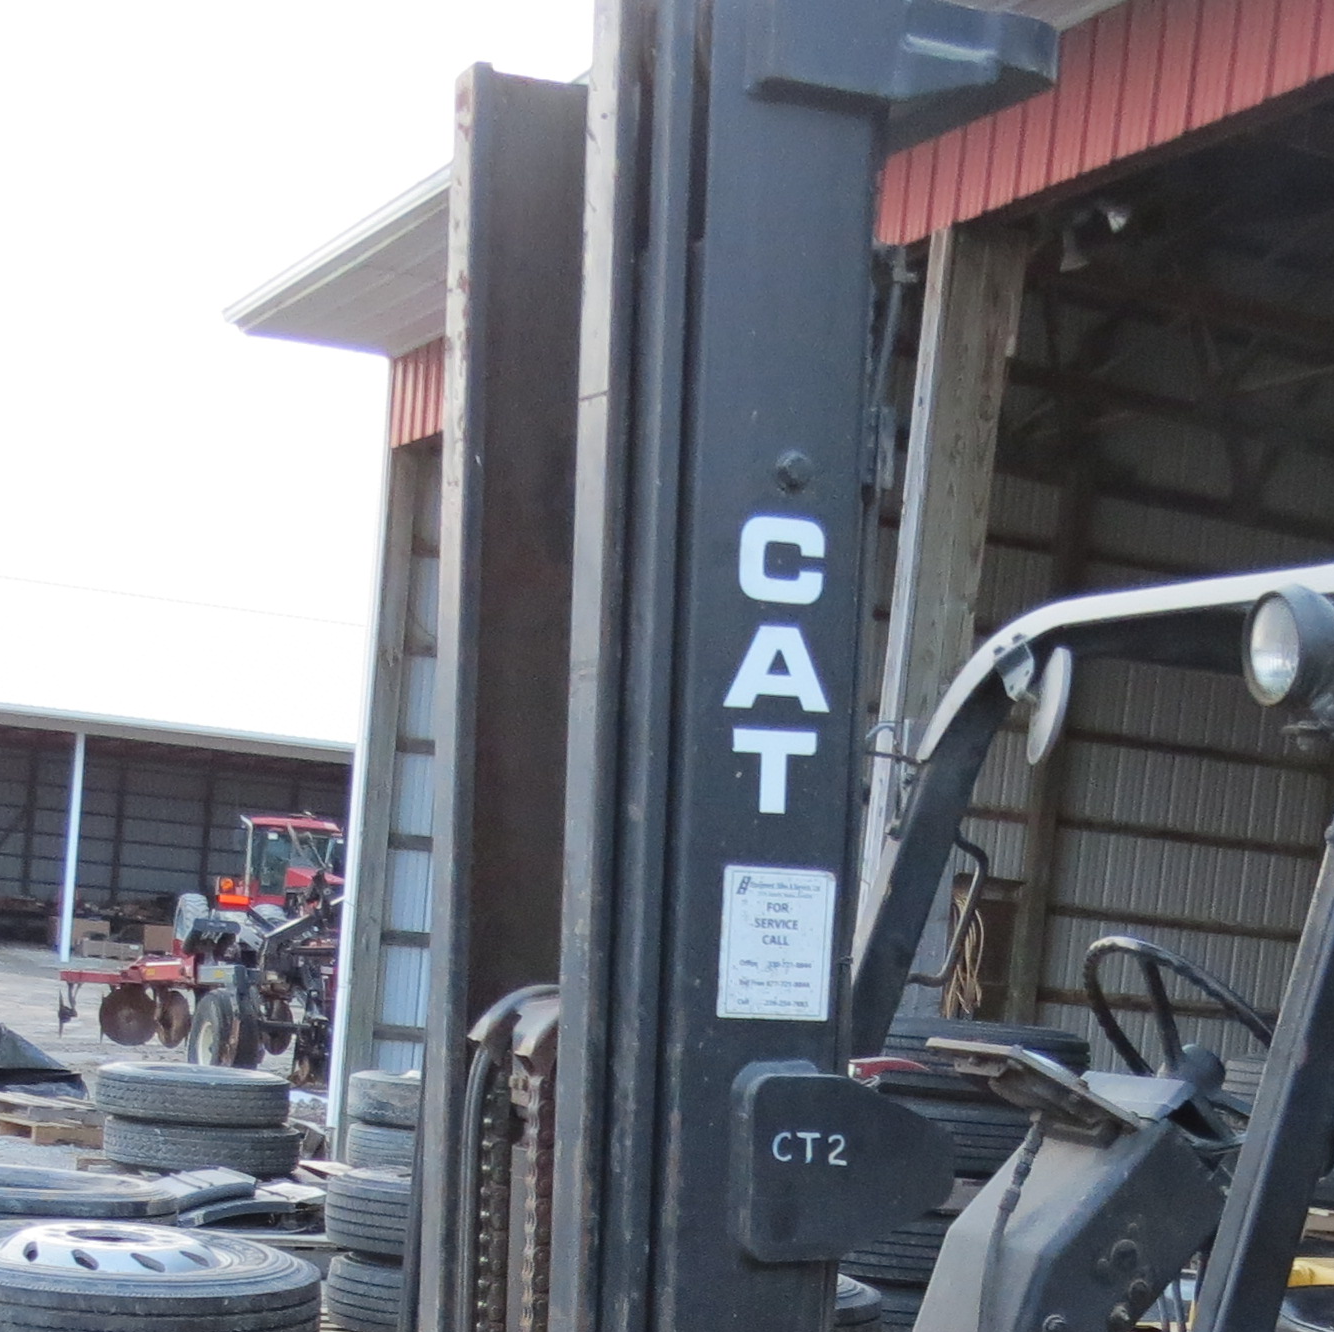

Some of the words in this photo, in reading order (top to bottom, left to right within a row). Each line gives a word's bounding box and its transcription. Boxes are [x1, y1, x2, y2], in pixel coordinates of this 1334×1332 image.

[723, 516, 830, 815] CAT
[767, 902, 789, 913] FOR
[754, 918, 798, 930] SERVICE
[762, 935, 789, 946] CALL
[772, 1131, 847, 1166] CT2
